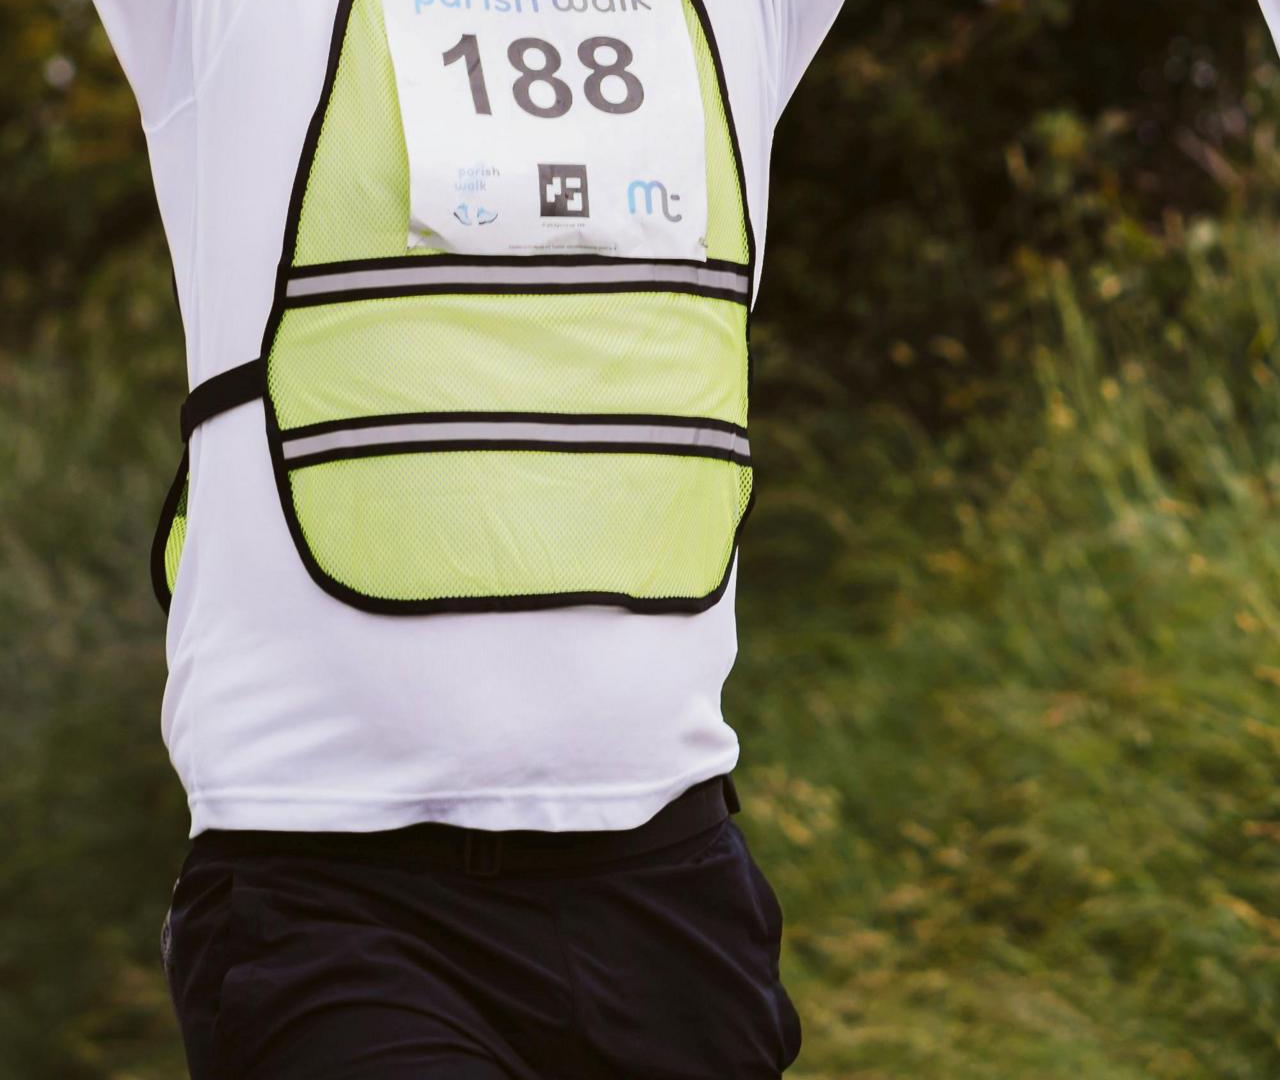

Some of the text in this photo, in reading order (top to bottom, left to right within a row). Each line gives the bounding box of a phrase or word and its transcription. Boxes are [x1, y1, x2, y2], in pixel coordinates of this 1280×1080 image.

[442, 33, 645, 118] 188
[458, 167, 501, 180] parish
[454, 178, 488, 193] walk
